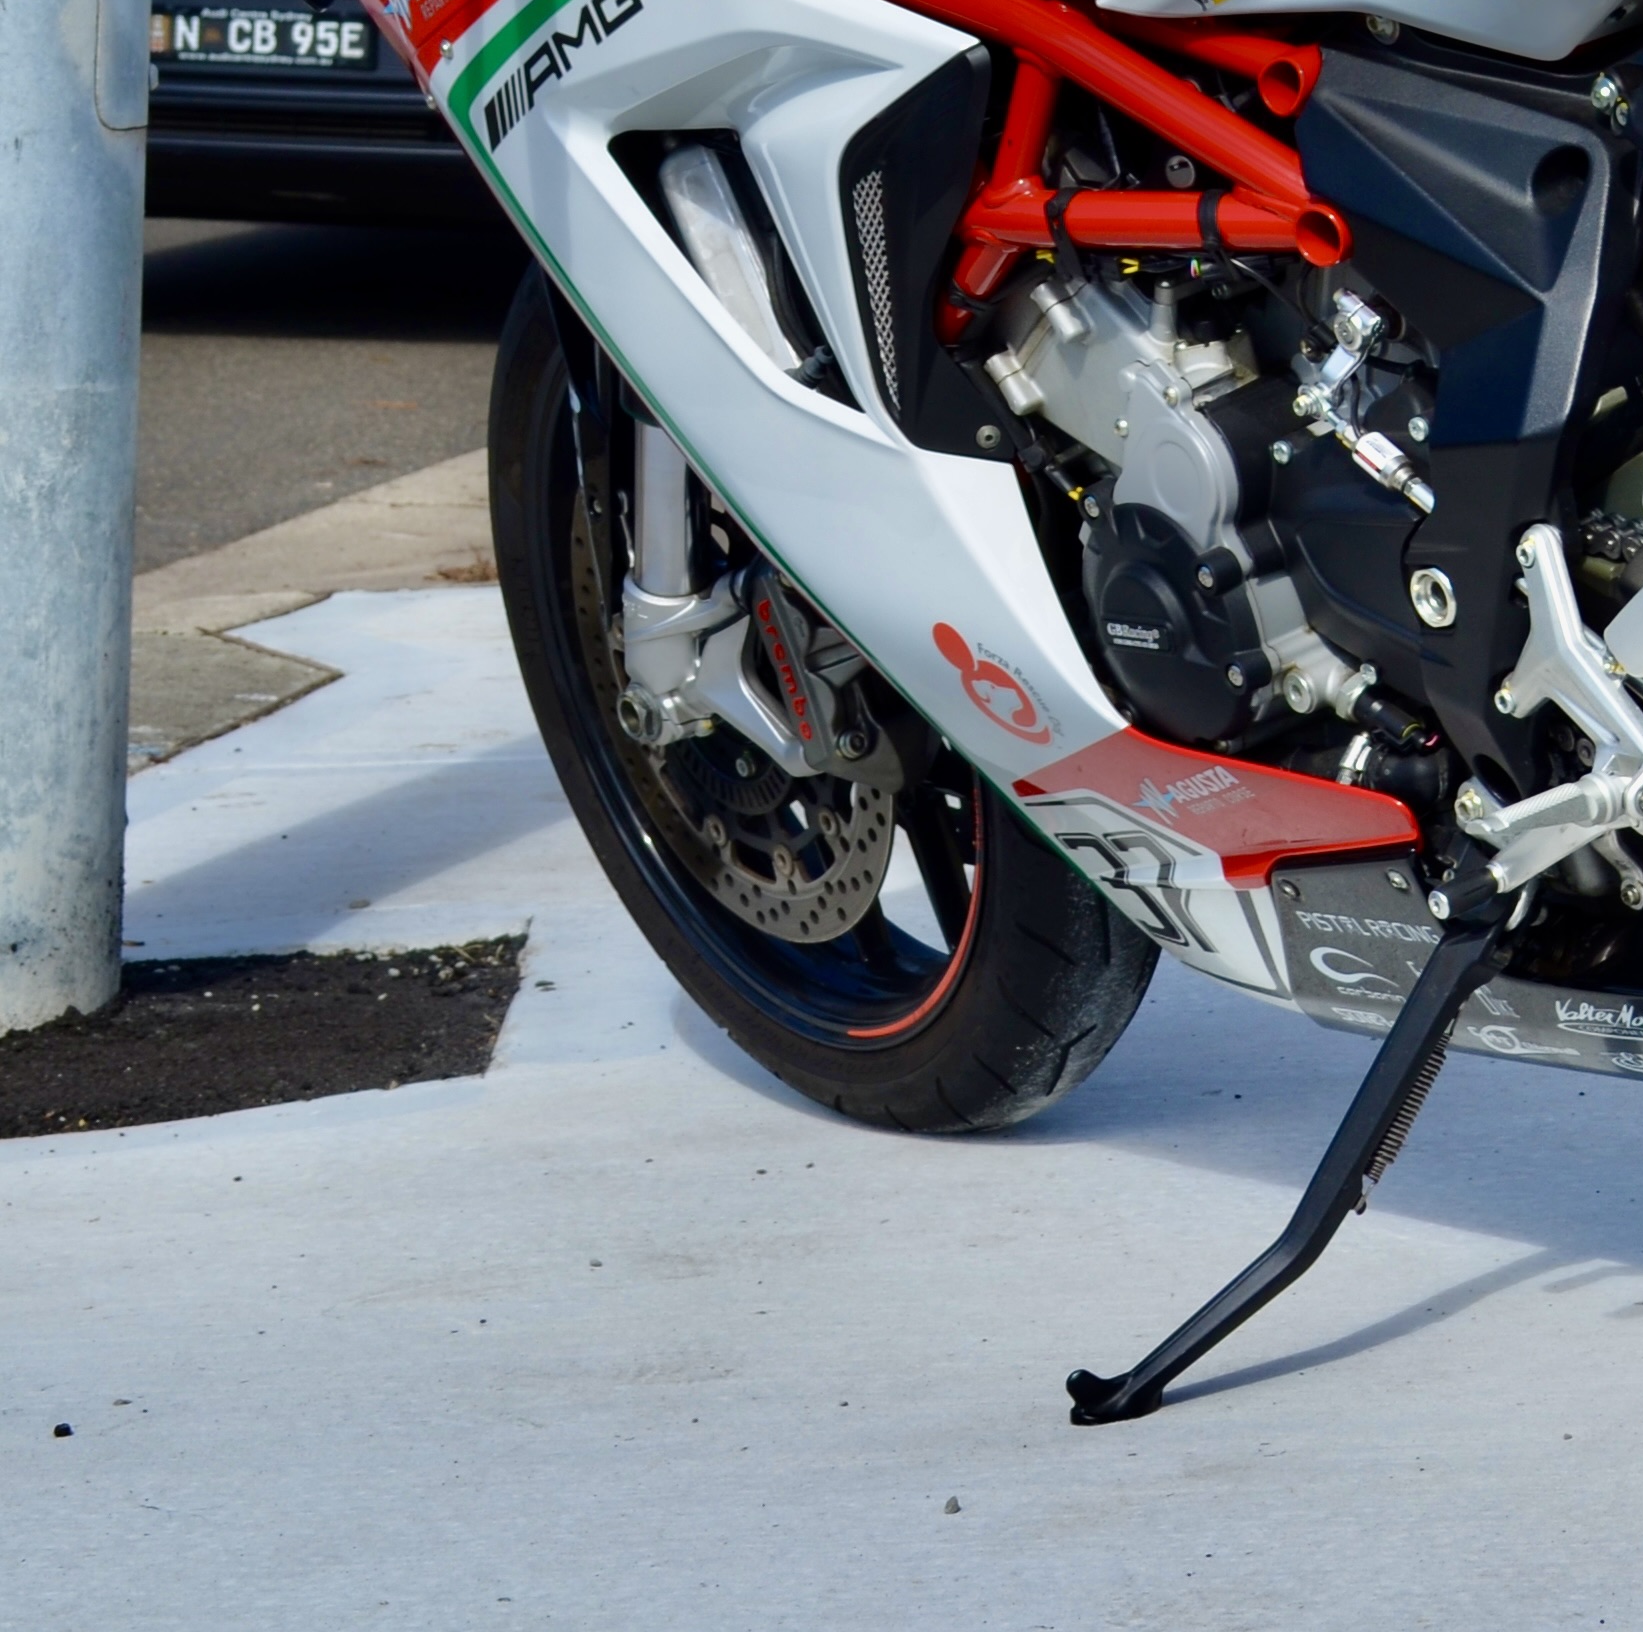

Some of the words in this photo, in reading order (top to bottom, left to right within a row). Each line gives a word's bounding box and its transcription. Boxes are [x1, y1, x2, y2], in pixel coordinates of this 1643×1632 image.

[228, 18, 277, 54] CB
[291, 21, 365, 58] 95E
[757, 599, 812, 741] brembo
[1166, 765, 1240, 804] AGUSTA
[1555, 997, 1615, 1024] Valter
